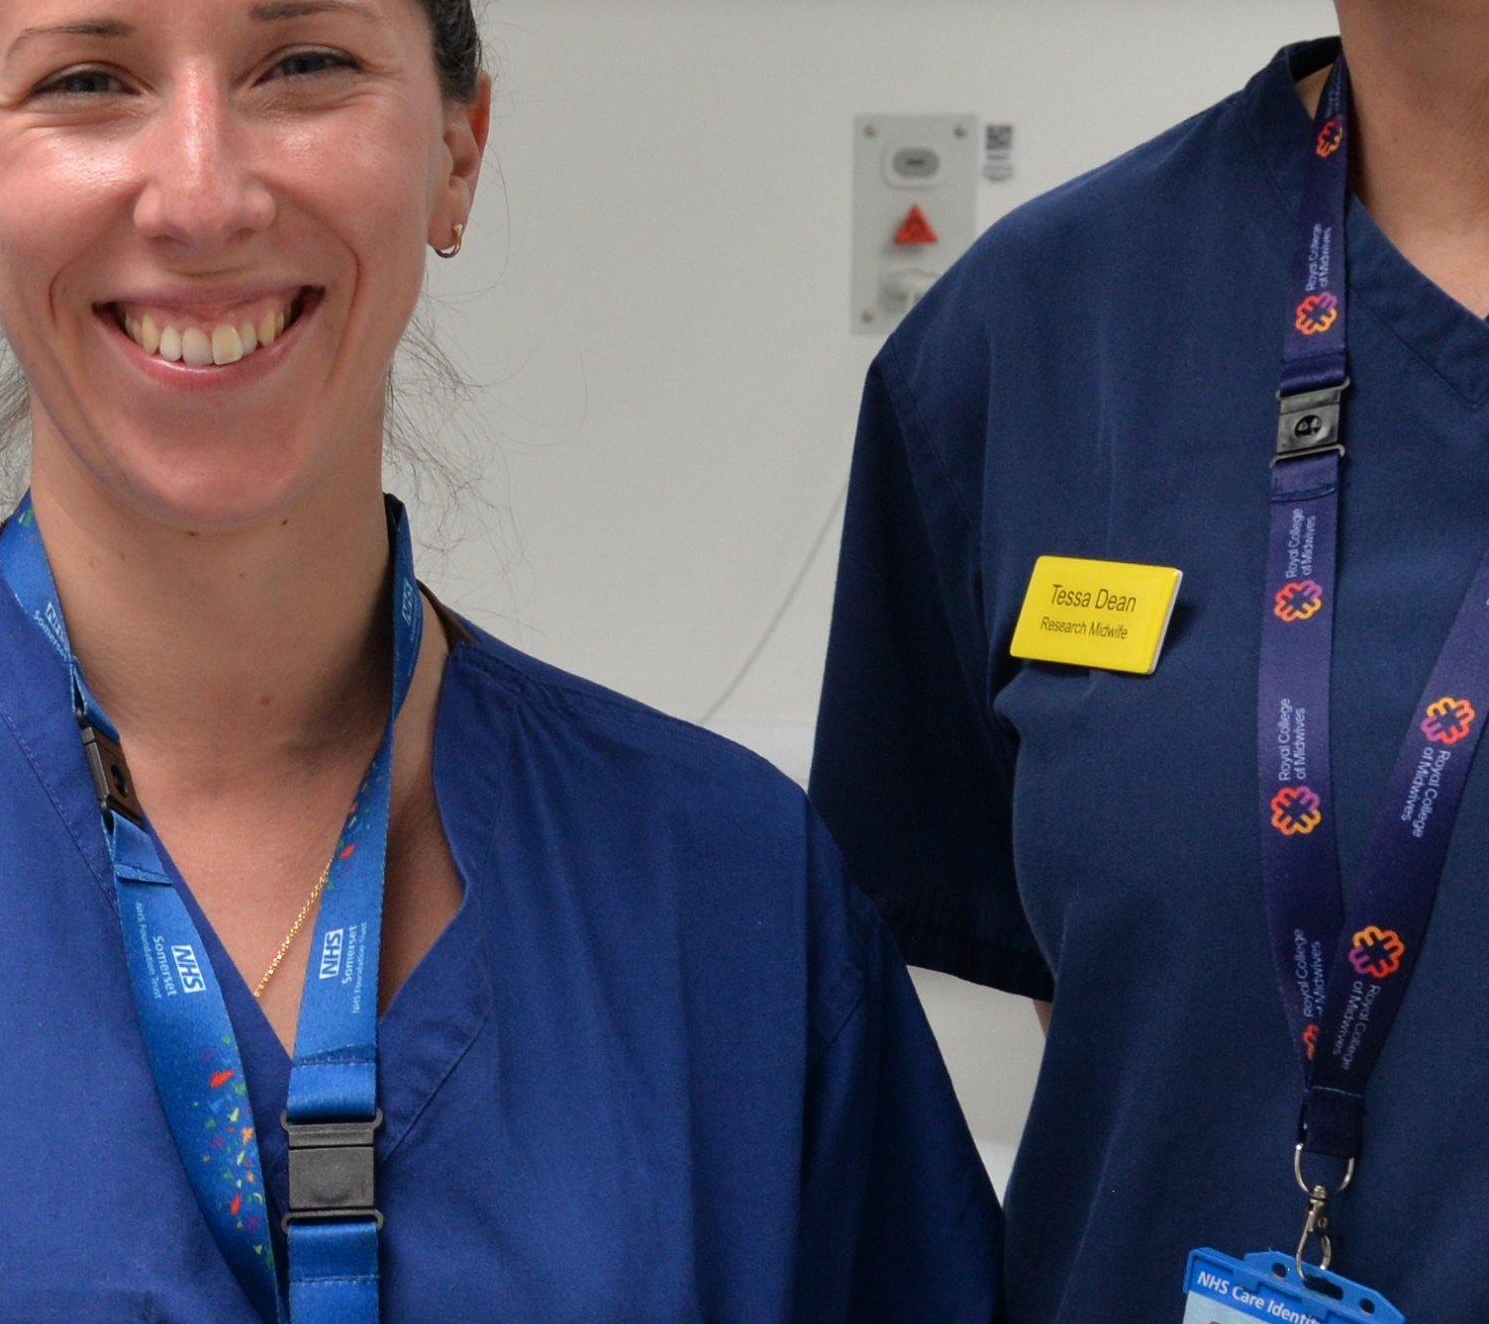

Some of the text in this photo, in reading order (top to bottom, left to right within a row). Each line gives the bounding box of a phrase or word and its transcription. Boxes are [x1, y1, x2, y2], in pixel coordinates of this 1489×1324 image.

[1285, 508, 1305, 579] Royal College
[1301, 515, 1316, 576] of Midwives
[1040, 616, 1128, 640] Research Midwife
[1050, 584, 1137, 613] Tessa Dean
[1278, 698, 1293, 781] Royal College
[1293, 707, 1306, 780] of Midwives
[1401, 747, 1434, 821] of Midwives
[1412, 749, 1451, 838] Royal College
[135, 902, 162, 1000] NHS Foundation Trust
[152, 935, 177, 997] Somerset
[172, 946, 205, 991] NHS
[321, 931, 342, 977] NHS
[342, 925, 357, 985] Somerset
[1294, 928, 1314, 1018] Royal College
[1311, 940, 1326, 1004] Midwives
[1332, 980, 1363, 1056] of Midwives
[1341, 984, 1381, 1071] Royal College
[1196, 1270, 1229, 1296] NHS
[1232, 1284, 1266, 1310] Care
